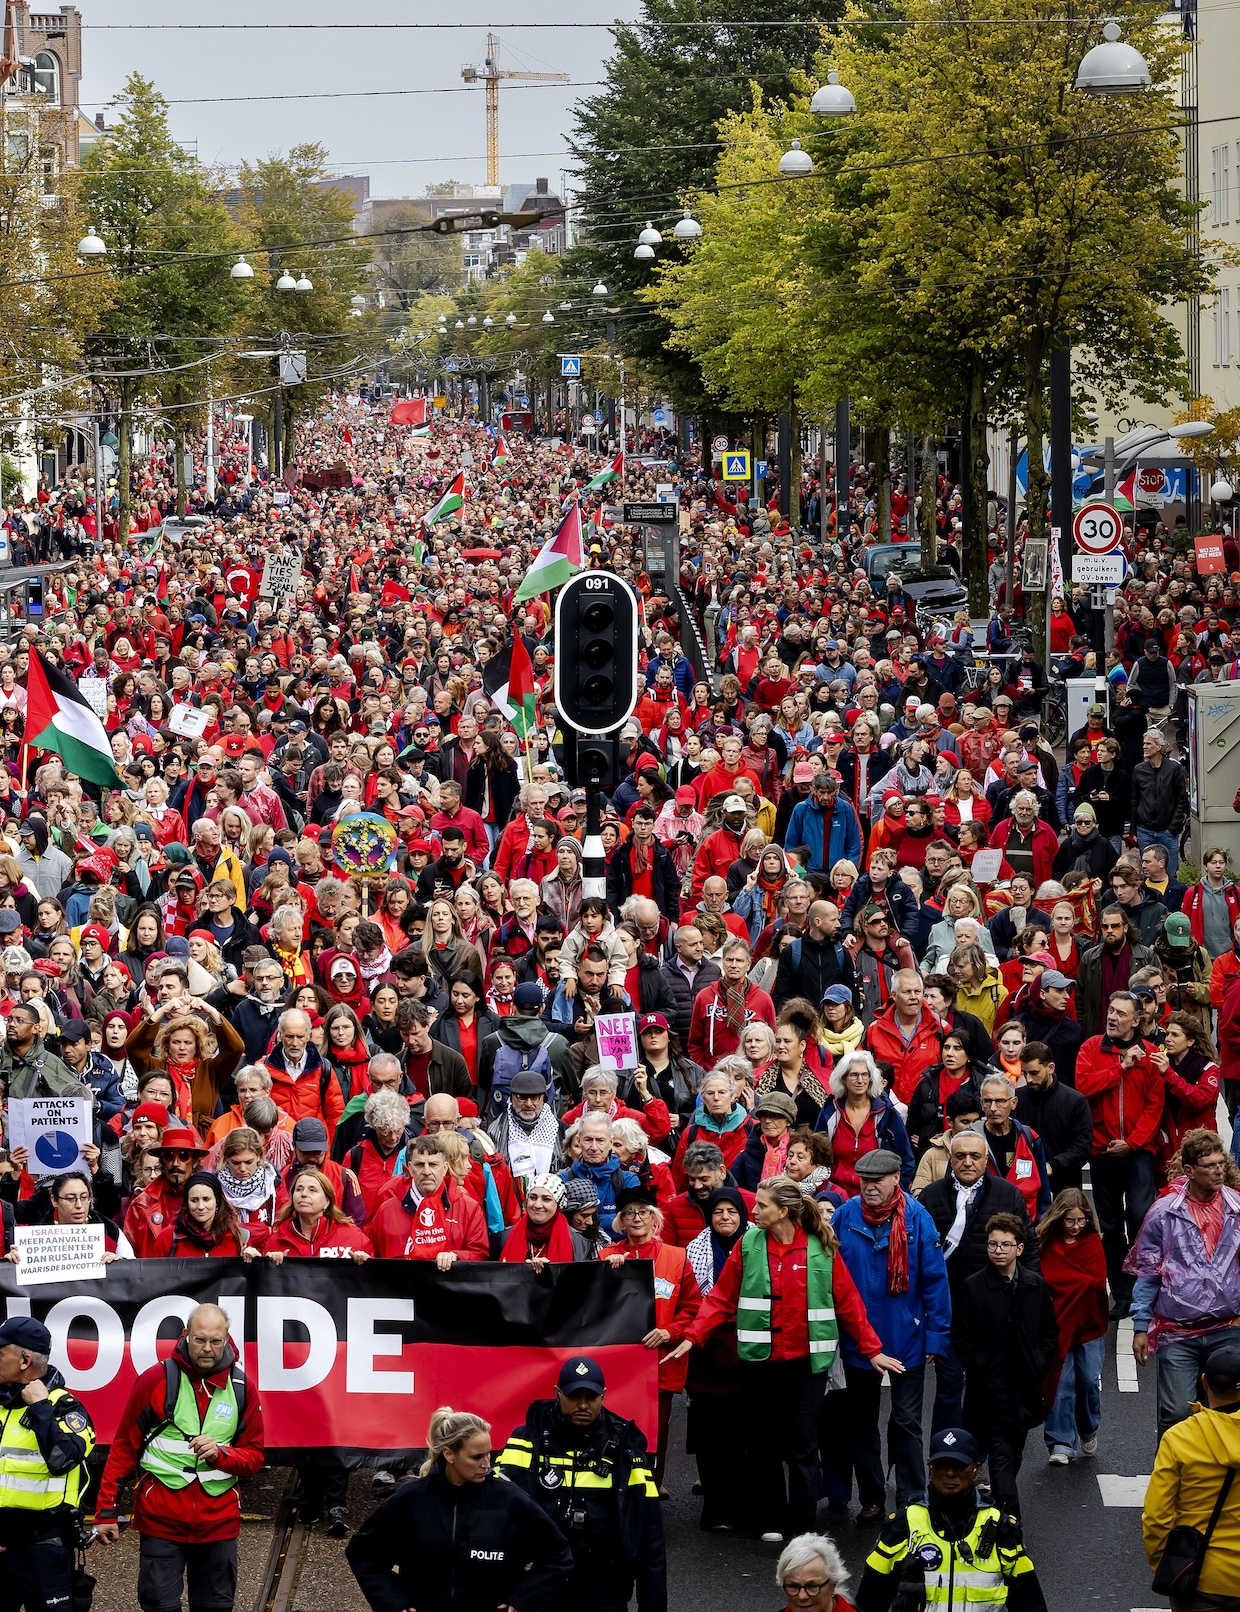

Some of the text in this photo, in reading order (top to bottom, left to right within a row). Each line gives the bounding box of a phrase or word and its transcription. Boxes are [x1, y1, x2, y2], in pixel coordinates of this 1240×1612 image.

[716, 440, 727, 448] 30
[1139, 474, 1164, 486] STOP
[1083, 519, 1114, 539] 30
[268, 555, 300, 568] SANC-
[269, 567, 293, 577] TIES
[586, 578, 609, 589] 091
[598, 1018, 632, 1036] NEE
[32, 1100, 75, 1109] ATTACKS
[31, 1116, 79, 1126] PATIENTS
[31, 1227, 87, 1236] ISRAEL: 12X
[415, 1227, 444, 1237] Save the
[19, 1235, 100, 1246] MEER AANVALLEN
[415, 1235, 446, 1245] Children
[26, 1242, 94, 1255] OP PATIËNTEN
[319, 1246, 352, 1259] PAX
[27, 1252, 94, 1264] DAN RUSLAND
[20, 1266, 43, 1275] WAAR
[217, 1403, 233, 1416] FNV
